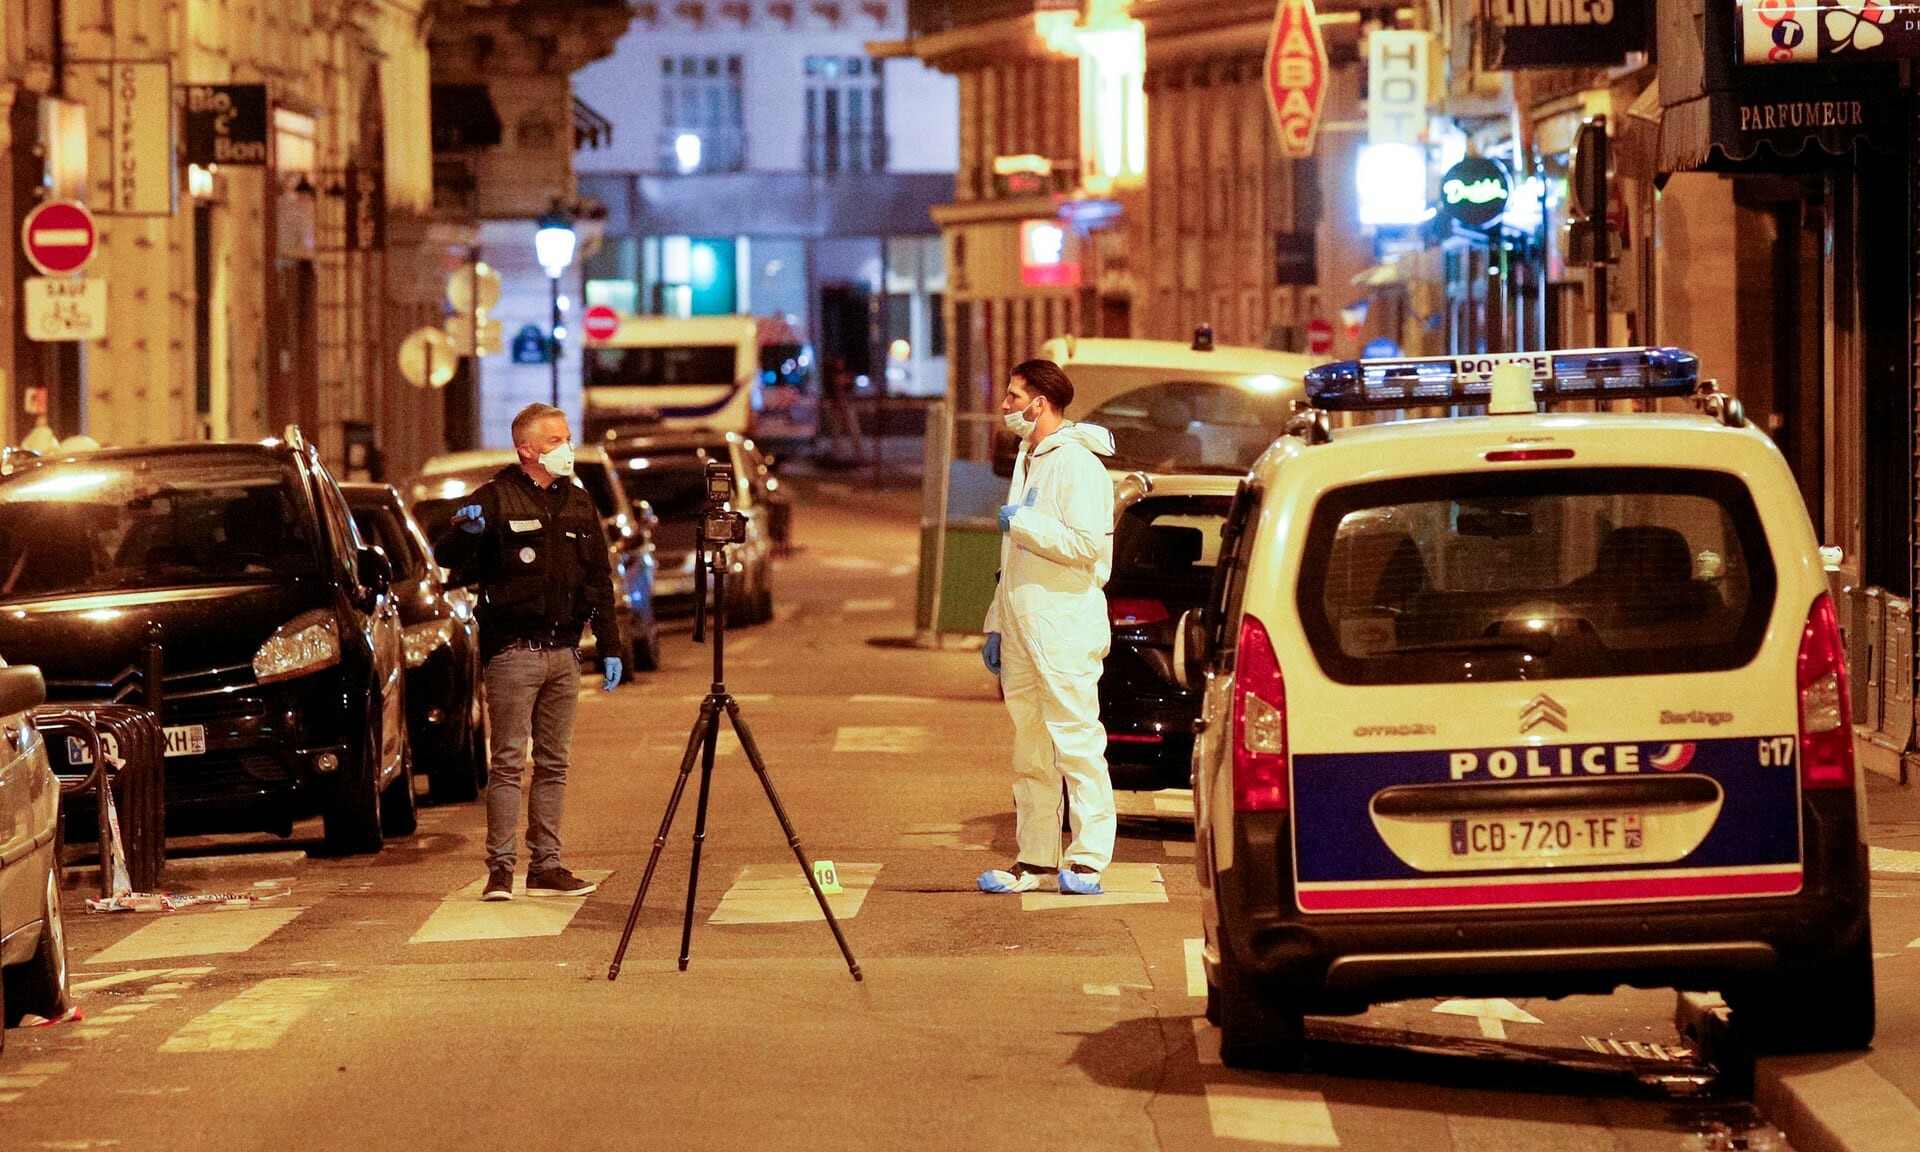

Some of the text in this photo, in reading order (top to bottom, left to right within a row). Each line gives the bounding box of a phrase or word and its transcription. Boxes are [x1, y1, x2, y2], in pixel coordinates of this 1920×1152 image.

[1278, 0, 1314, 146] TABAC
[1740, 101, 1863, 131] PARFUMEUR
[1461, 357, 1548, 380] POE
[1659, 709, 1734, 727] Berlingo
[1451, 745, 1640, 781] POLICE
[816, 869, 834, 885] 19
